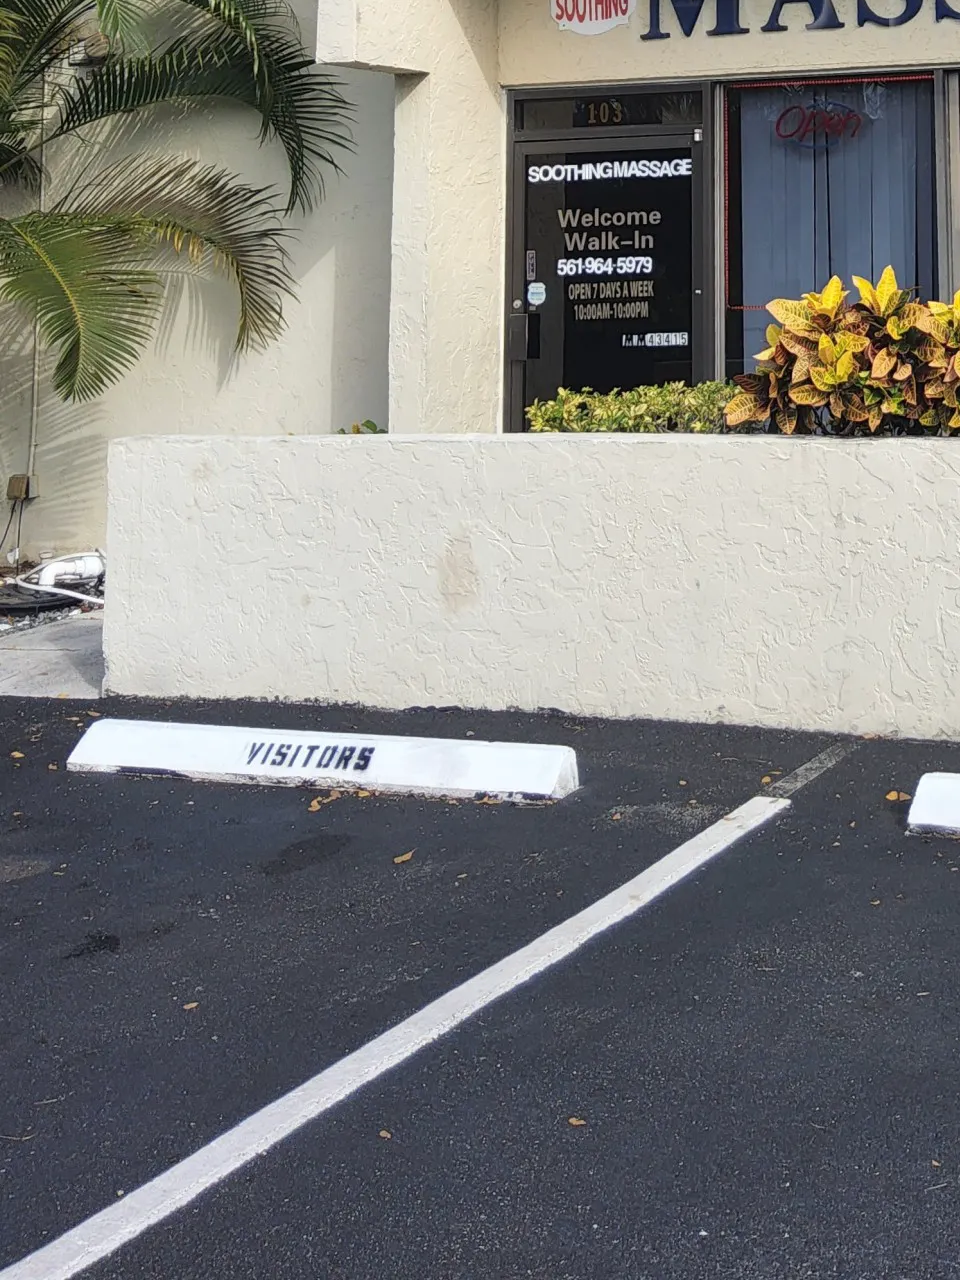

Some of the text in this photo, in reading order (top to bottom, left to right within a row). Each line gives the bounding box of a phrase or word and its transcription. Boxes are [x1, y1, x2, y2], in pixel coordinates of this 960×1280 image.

[587, 102, 623, 124] 103
[775, 105, 863, 142] Open
[557, 208, 662, 228] Welcome
[564, 230, 654, 252] Walk-In
[557, 256, 653, 276] 561-964-5979
[568, 280, 654, 300] OPEN 7 DAYS A WEEK
[573, 300, 649, 321] 10:00AM-10:00PM
[246, 742, 376, 772] VISITORS
